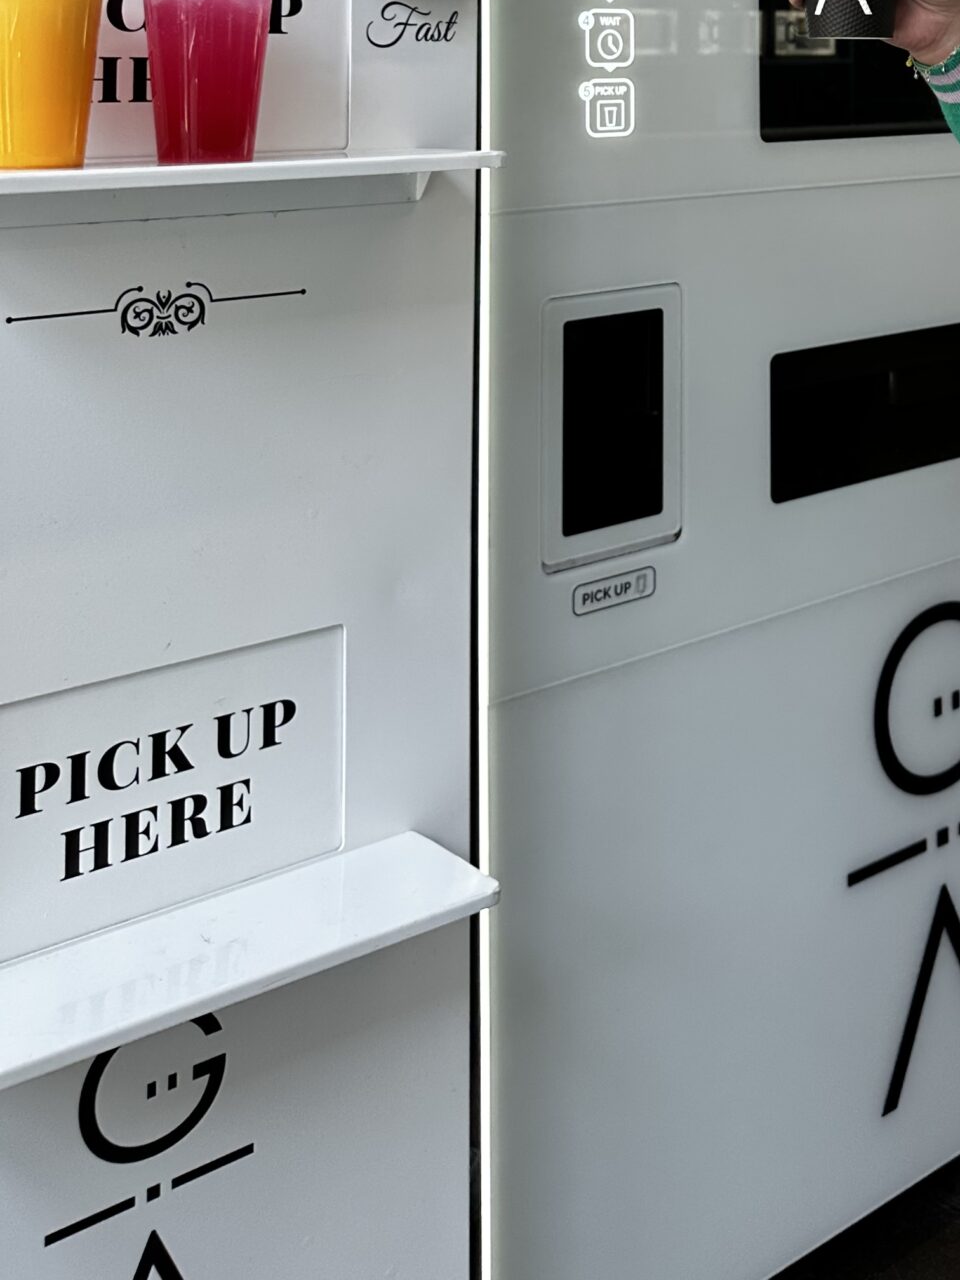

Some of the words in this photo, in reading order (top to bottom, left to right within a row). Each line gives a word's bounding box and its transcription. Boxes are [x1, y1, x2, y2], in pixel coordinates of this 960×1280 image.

[366, 1, 459, 48] Fast
[599, 16, 621, 27] WAIT
[595, 85, 615, 96] PICK
[615, 86, 628, 96] UP
[582, 586, 612, 606] PICK
[614, 581, 632, 596] UP
[14, 722, 196, 819] PICK
[213, 698, 297, 760] UP
[61, 778, 253, 882] HERE
